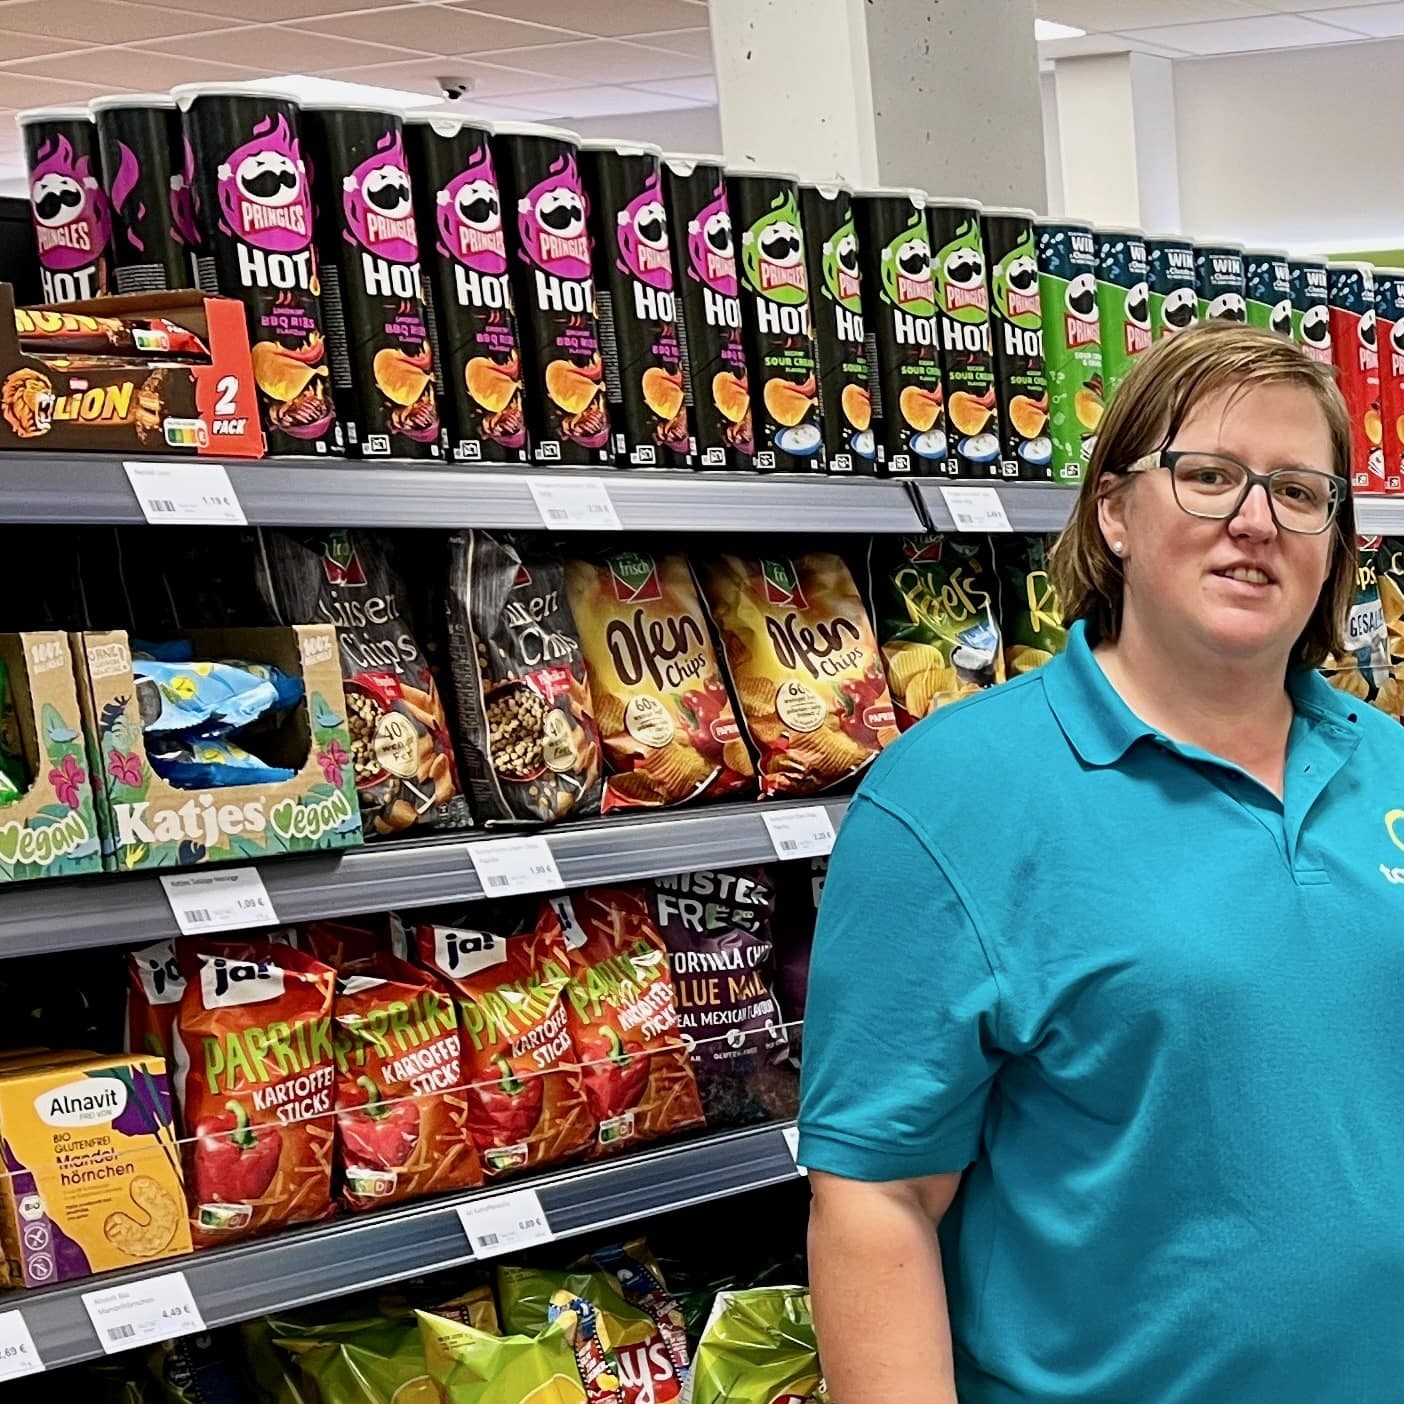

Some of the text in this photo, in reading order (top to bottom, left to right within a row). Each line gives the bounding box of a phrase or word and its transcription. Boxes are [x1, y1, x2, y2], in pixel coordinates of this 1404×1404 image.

[241, 201, 306, 236] PRINGLES
[38, 222, 91, 254] PRINGLES
[237, 243, 312, 290] HOT
[1213, 259, 1240, 275] WIN
[41, 266, 96, 303] HOT
[535, 270, 594, 313] HOT
[261, 315, 287, 328] BBQ
[757, 296, 811, 336] HOT
[942, 317, 992, 351] HOT
[764, 356, 788, 367] SOUR
[215, 375, 239, 416] 2
[211, 418, 248, 436] PACK
[617, 562, 650, 578] frisch
[339, 632, 418, 674] Chips
[606, 607, 705, 692] Ofen
[819, 646, 864, 680] Chips
[666, 653, 707, 689] Chips
[114, 795, 264, 845] Katjes
[654, 869, 769, 906] MISTER
[445, 932, 495, 970] ja!
[213, 958, 272, 997] ja!
[700, 1007, 746, 1027] MEXICAN
[205, 1015, 334, 1094] PAPRIK
[532, 1027, 571, 1069] STICKS
[411, 1059, 461, 1097] STICKS
[49, 1090, 119, 1116] Alnavit
[276, 1091, 330, 1126] STICKS
[53, 1132, 71, 1144] BIO
[55, 1136, 111, 1154] GLUTENFREI
[60, 1162, 135, 1186] hörnchen
[161, 1306, 182, 1320] 4,49
